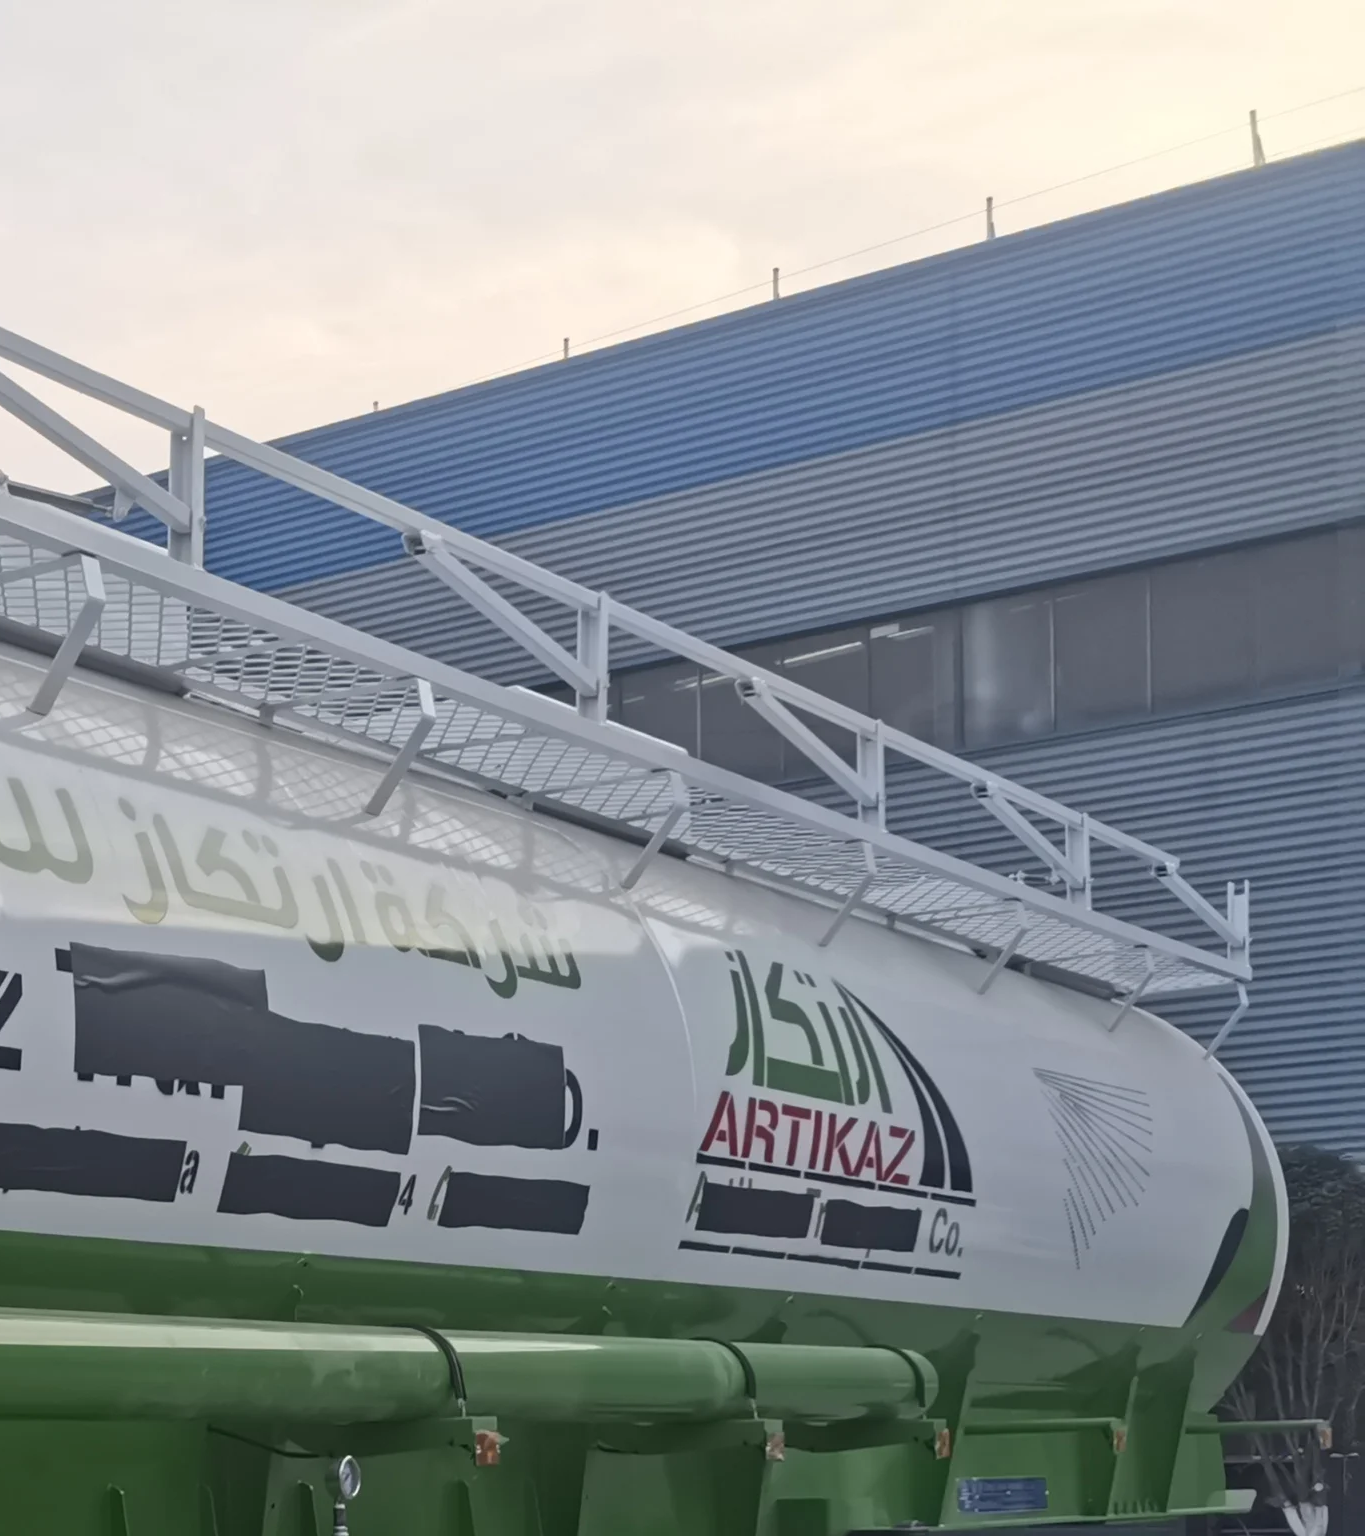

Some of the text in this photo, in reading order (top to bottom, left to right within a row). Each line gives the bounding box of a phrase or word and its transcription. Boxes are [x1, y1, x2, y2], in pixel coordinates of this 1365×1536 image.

[120, 796, 363, 961] ارتكاز
[361, 858, 582, 998] شركة
[699, 1090, 916, 1186] ARTIKAZ
[929, 1207, 963, 1258] Co.
